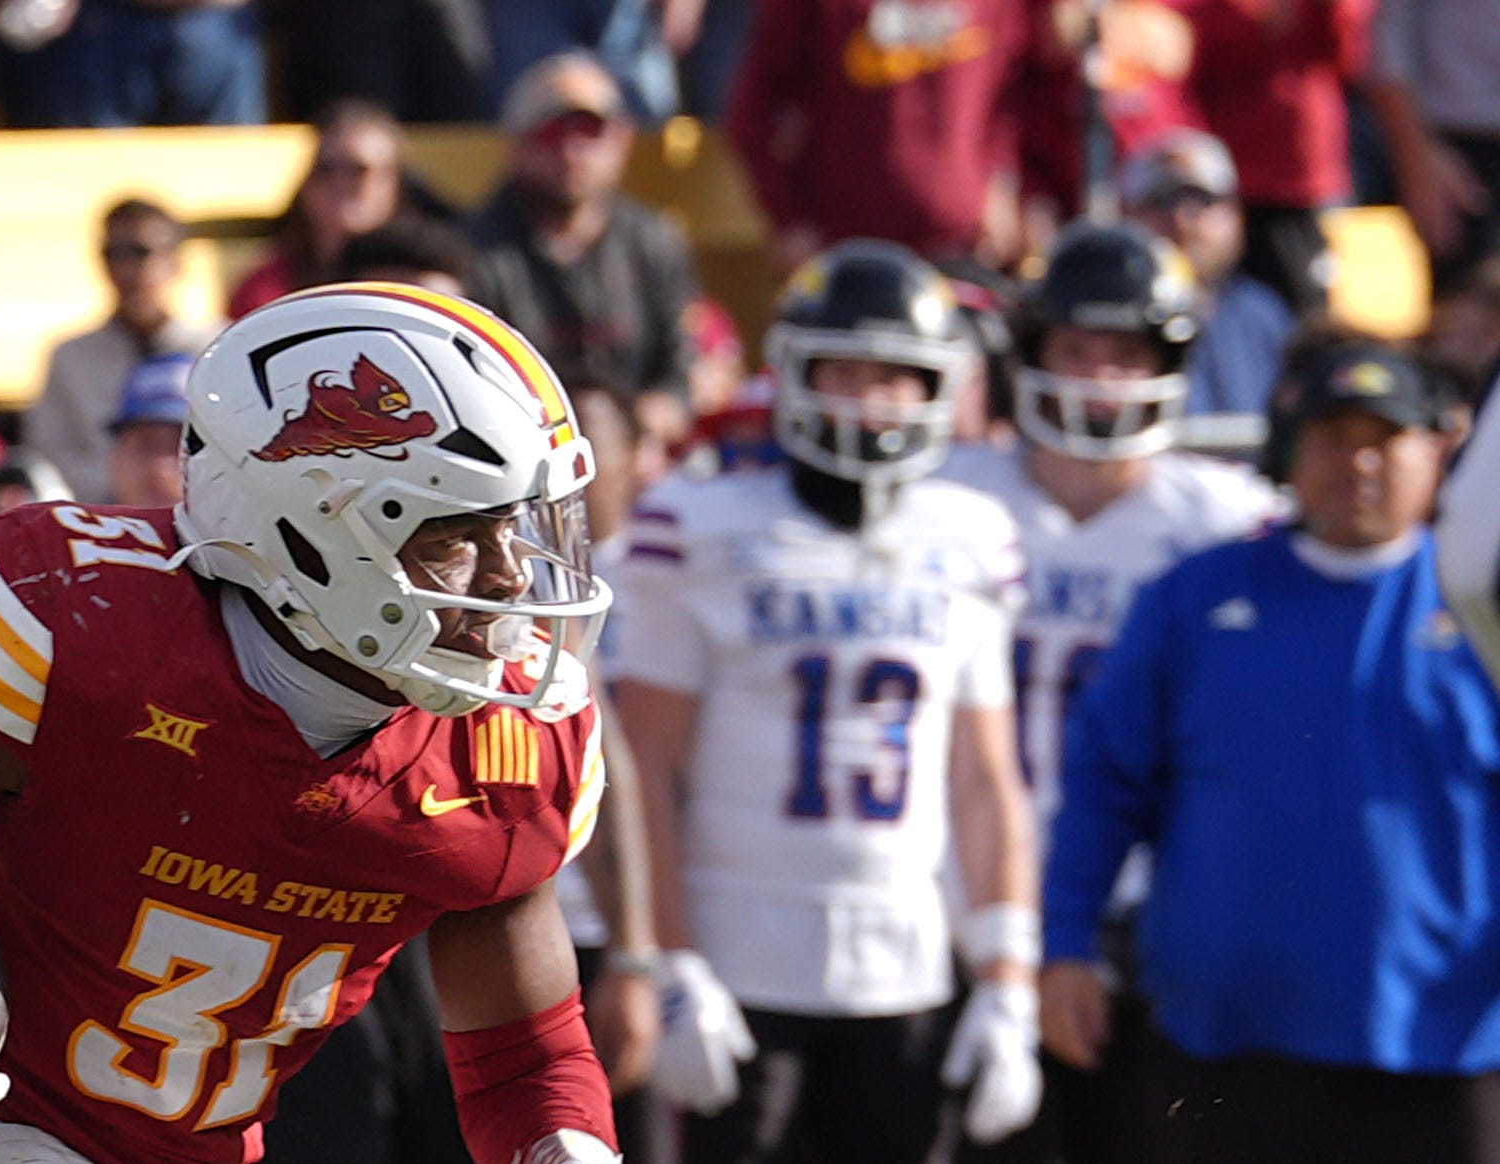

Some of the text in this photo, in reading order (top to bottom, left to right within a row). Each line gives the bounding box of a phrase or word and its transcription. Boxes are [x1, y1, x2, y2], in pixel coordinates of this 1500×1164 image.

[51, 505, 178, 576] 31
[134, 704, 211, 757] XII
[782, 652, 924, 823] 13
[139, 846, 405, 925] IOWA STATE
[67, 897, 356, 1132] 31
